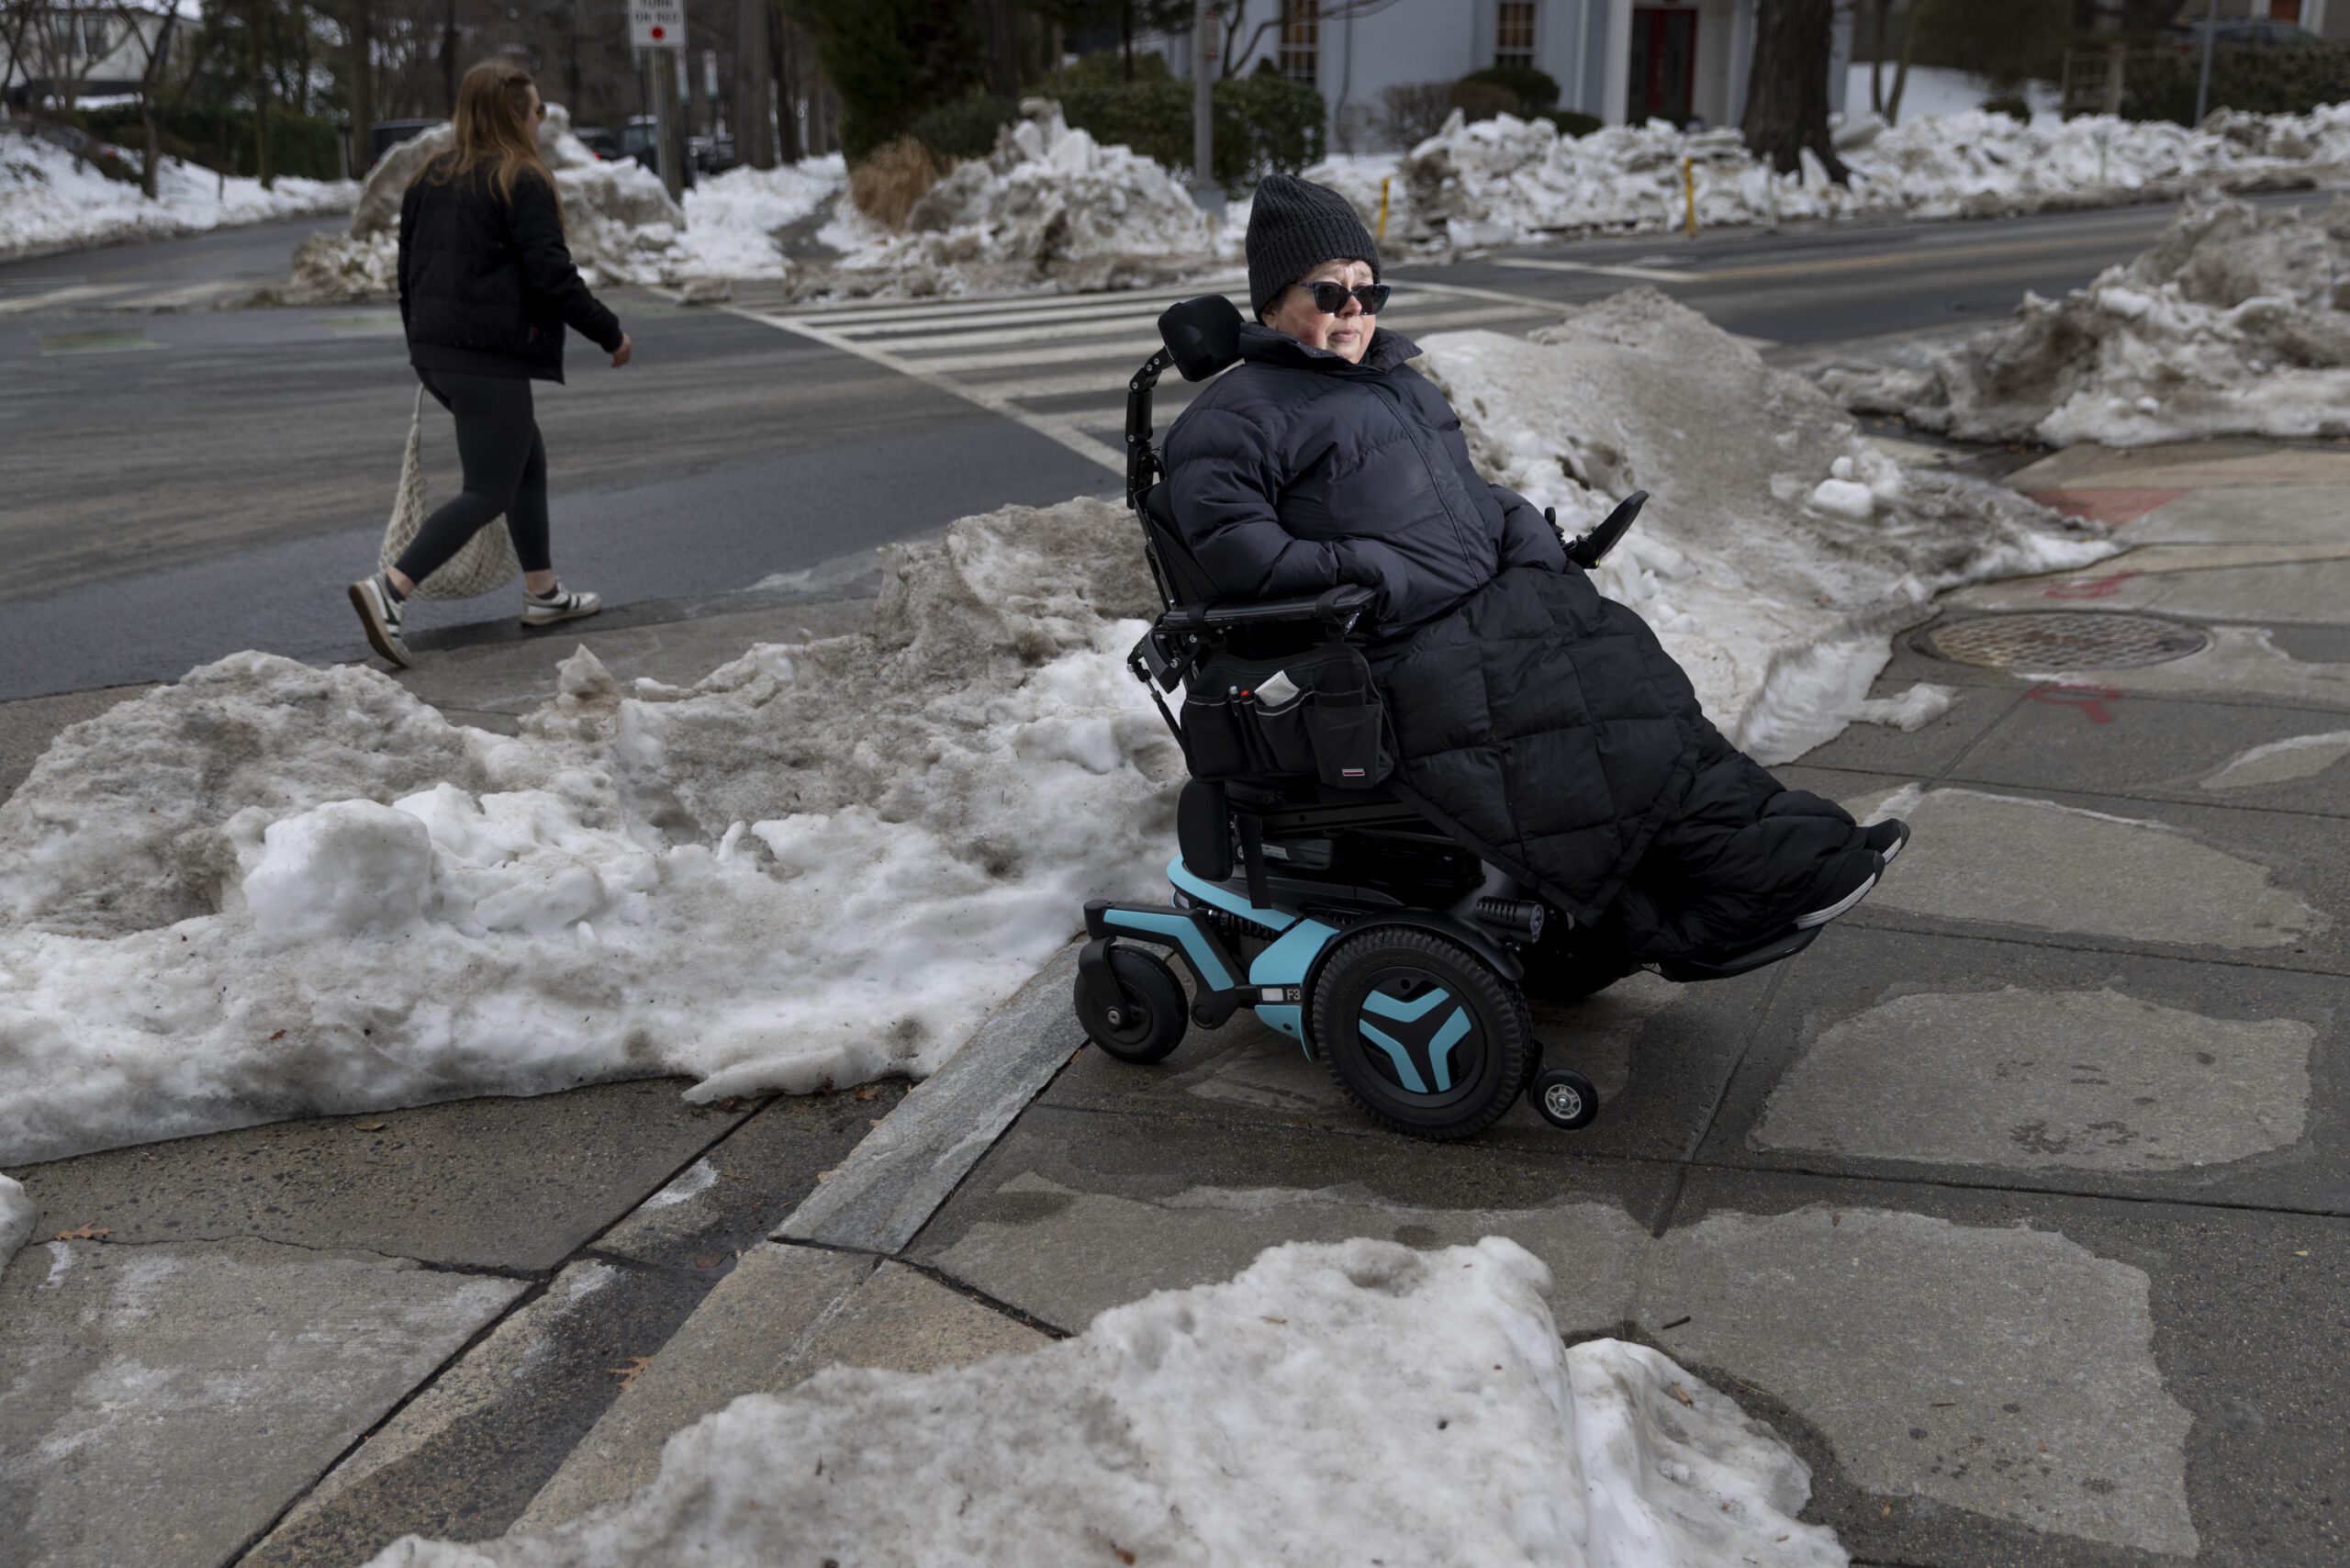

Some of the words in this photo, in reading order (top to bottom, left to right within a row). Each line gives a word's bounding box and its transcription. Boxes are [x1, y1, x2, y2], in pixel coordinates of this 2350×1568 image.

[635, 12, 652, 23] ON
[657, 12, 680, 24] RED
[1286, 988, 1301, 1001] F3
